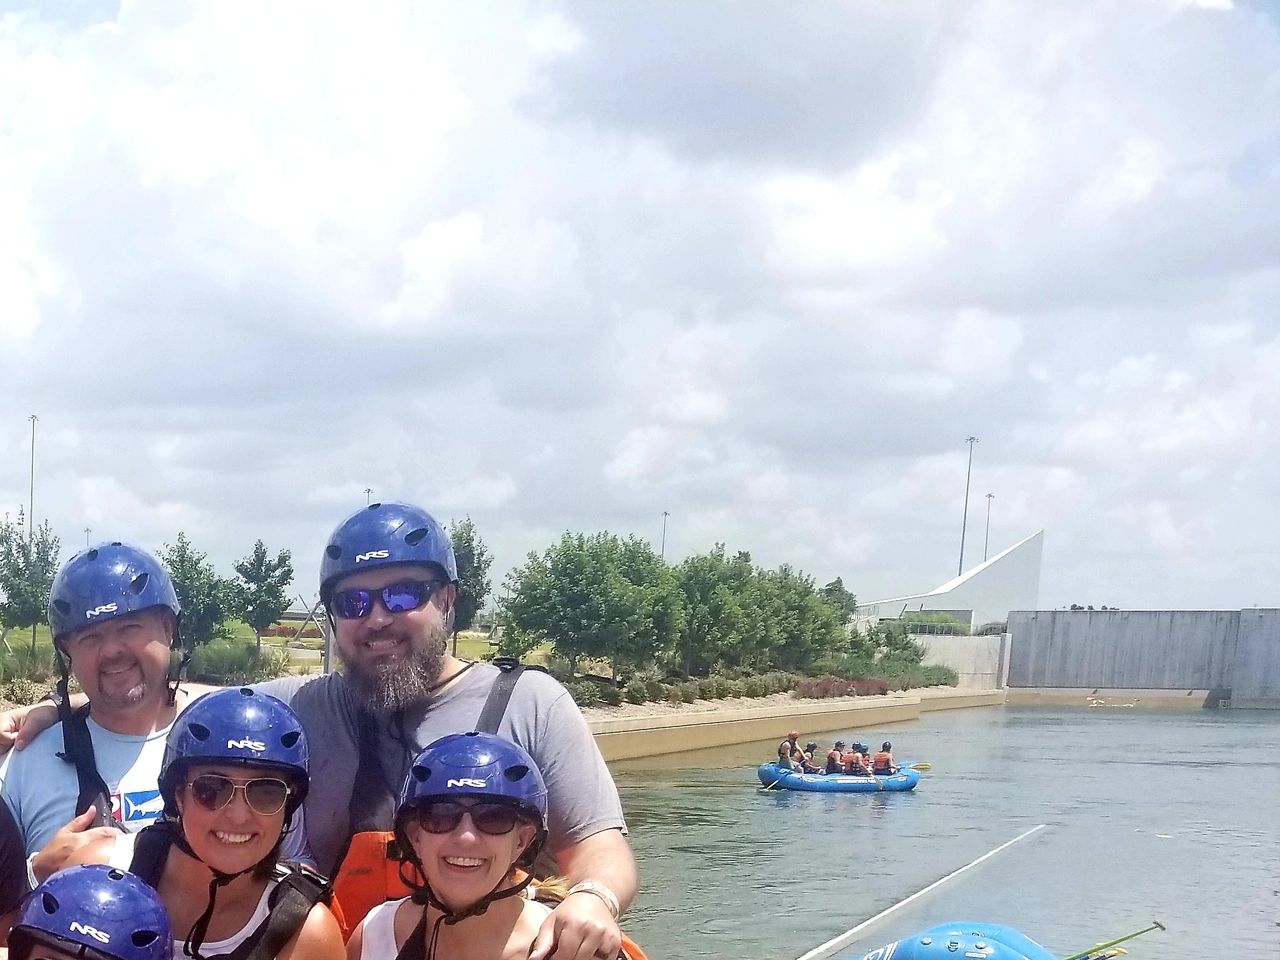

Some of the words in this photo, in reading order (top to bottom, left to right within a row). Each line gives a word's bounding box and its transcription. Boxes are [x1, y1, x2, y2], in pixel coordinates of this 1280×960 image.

[356, 549, 389, 563] NRS
[86, 602, 118, 618] NRS
[228, 740, 266, 751] NRS
[447, 778, 487, 788] NRS
[69, 921, 111, 944] NRS
